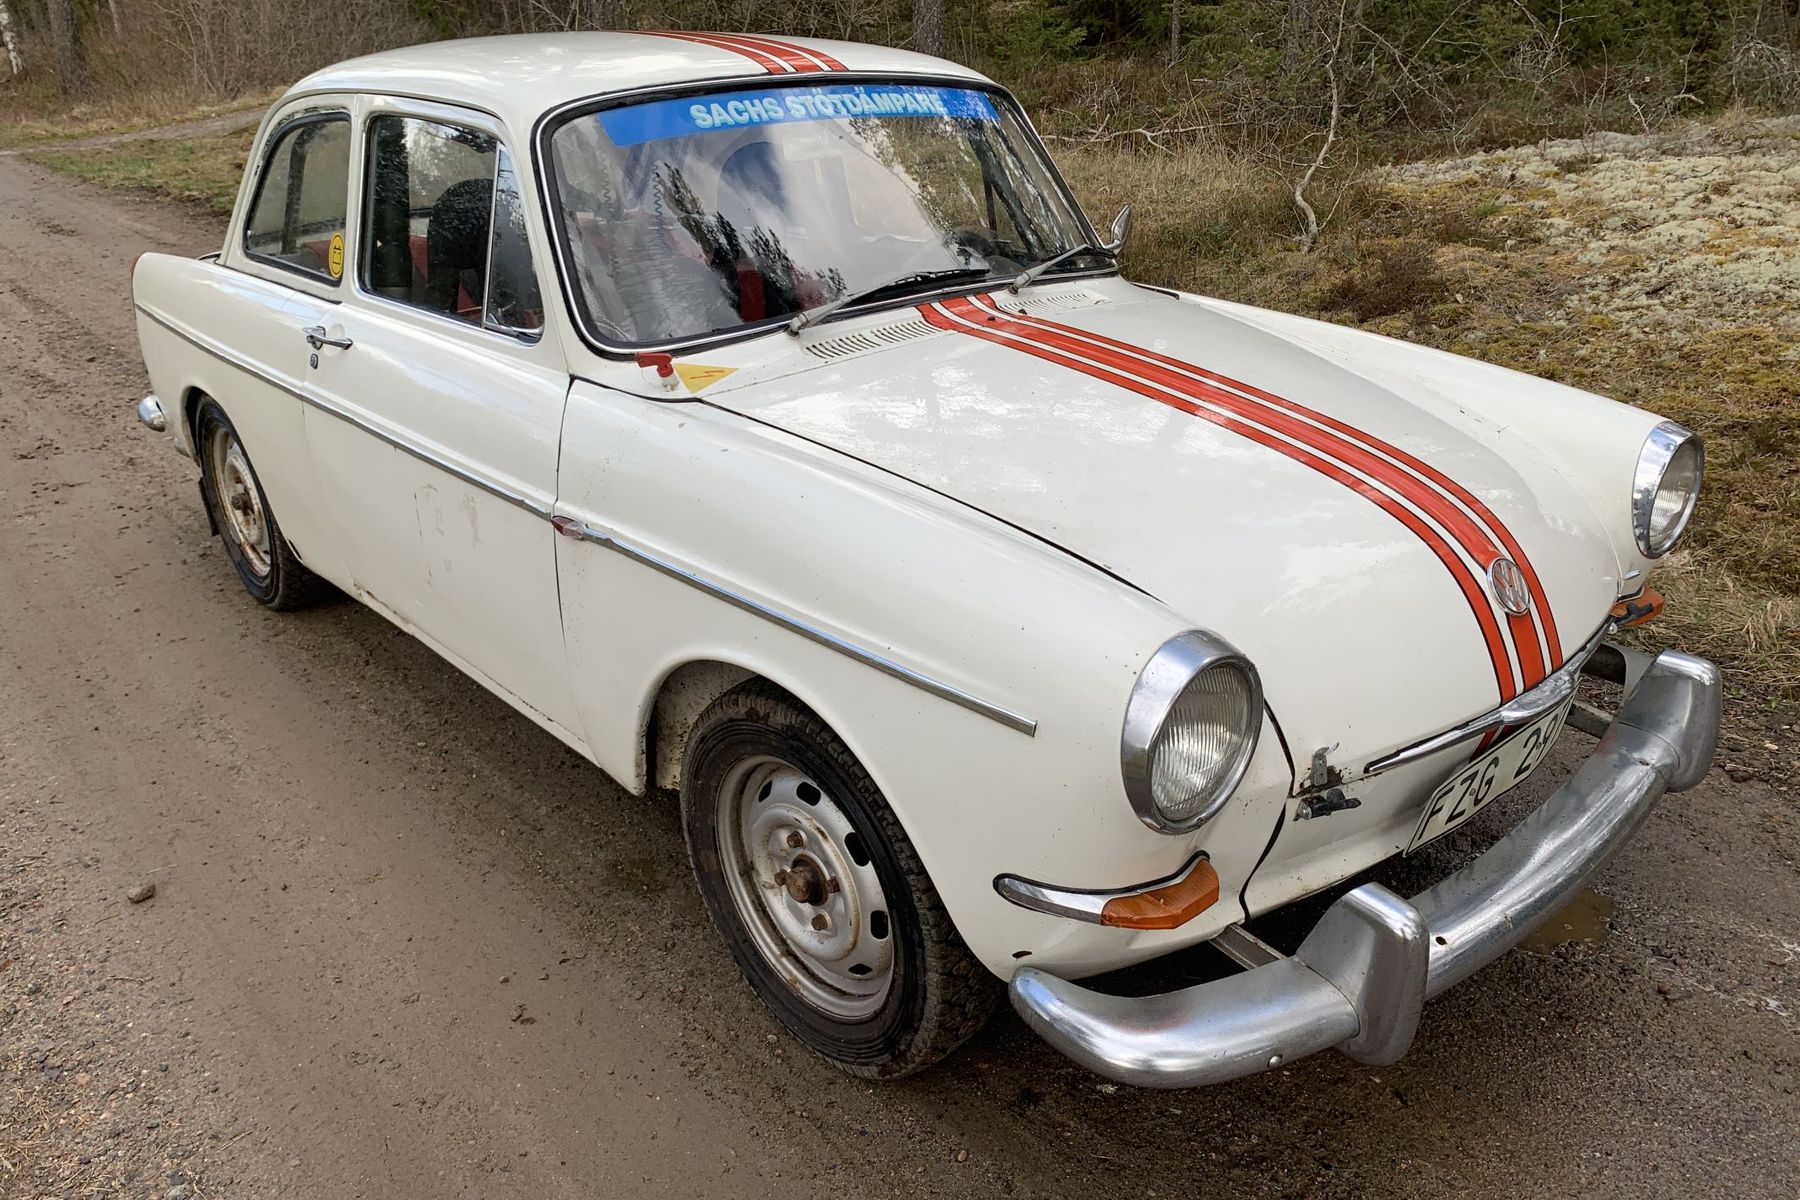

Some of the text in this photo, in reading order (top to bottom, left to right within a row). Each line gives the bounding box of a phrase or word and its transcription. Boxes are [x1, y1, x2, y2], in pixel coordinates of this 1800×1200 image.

[690, 87, 948, 128] SACHS STÖTDÄMPARE
[1491, 560, 1530, 614] VW
[1417, 756, 1500, 841] FZG
